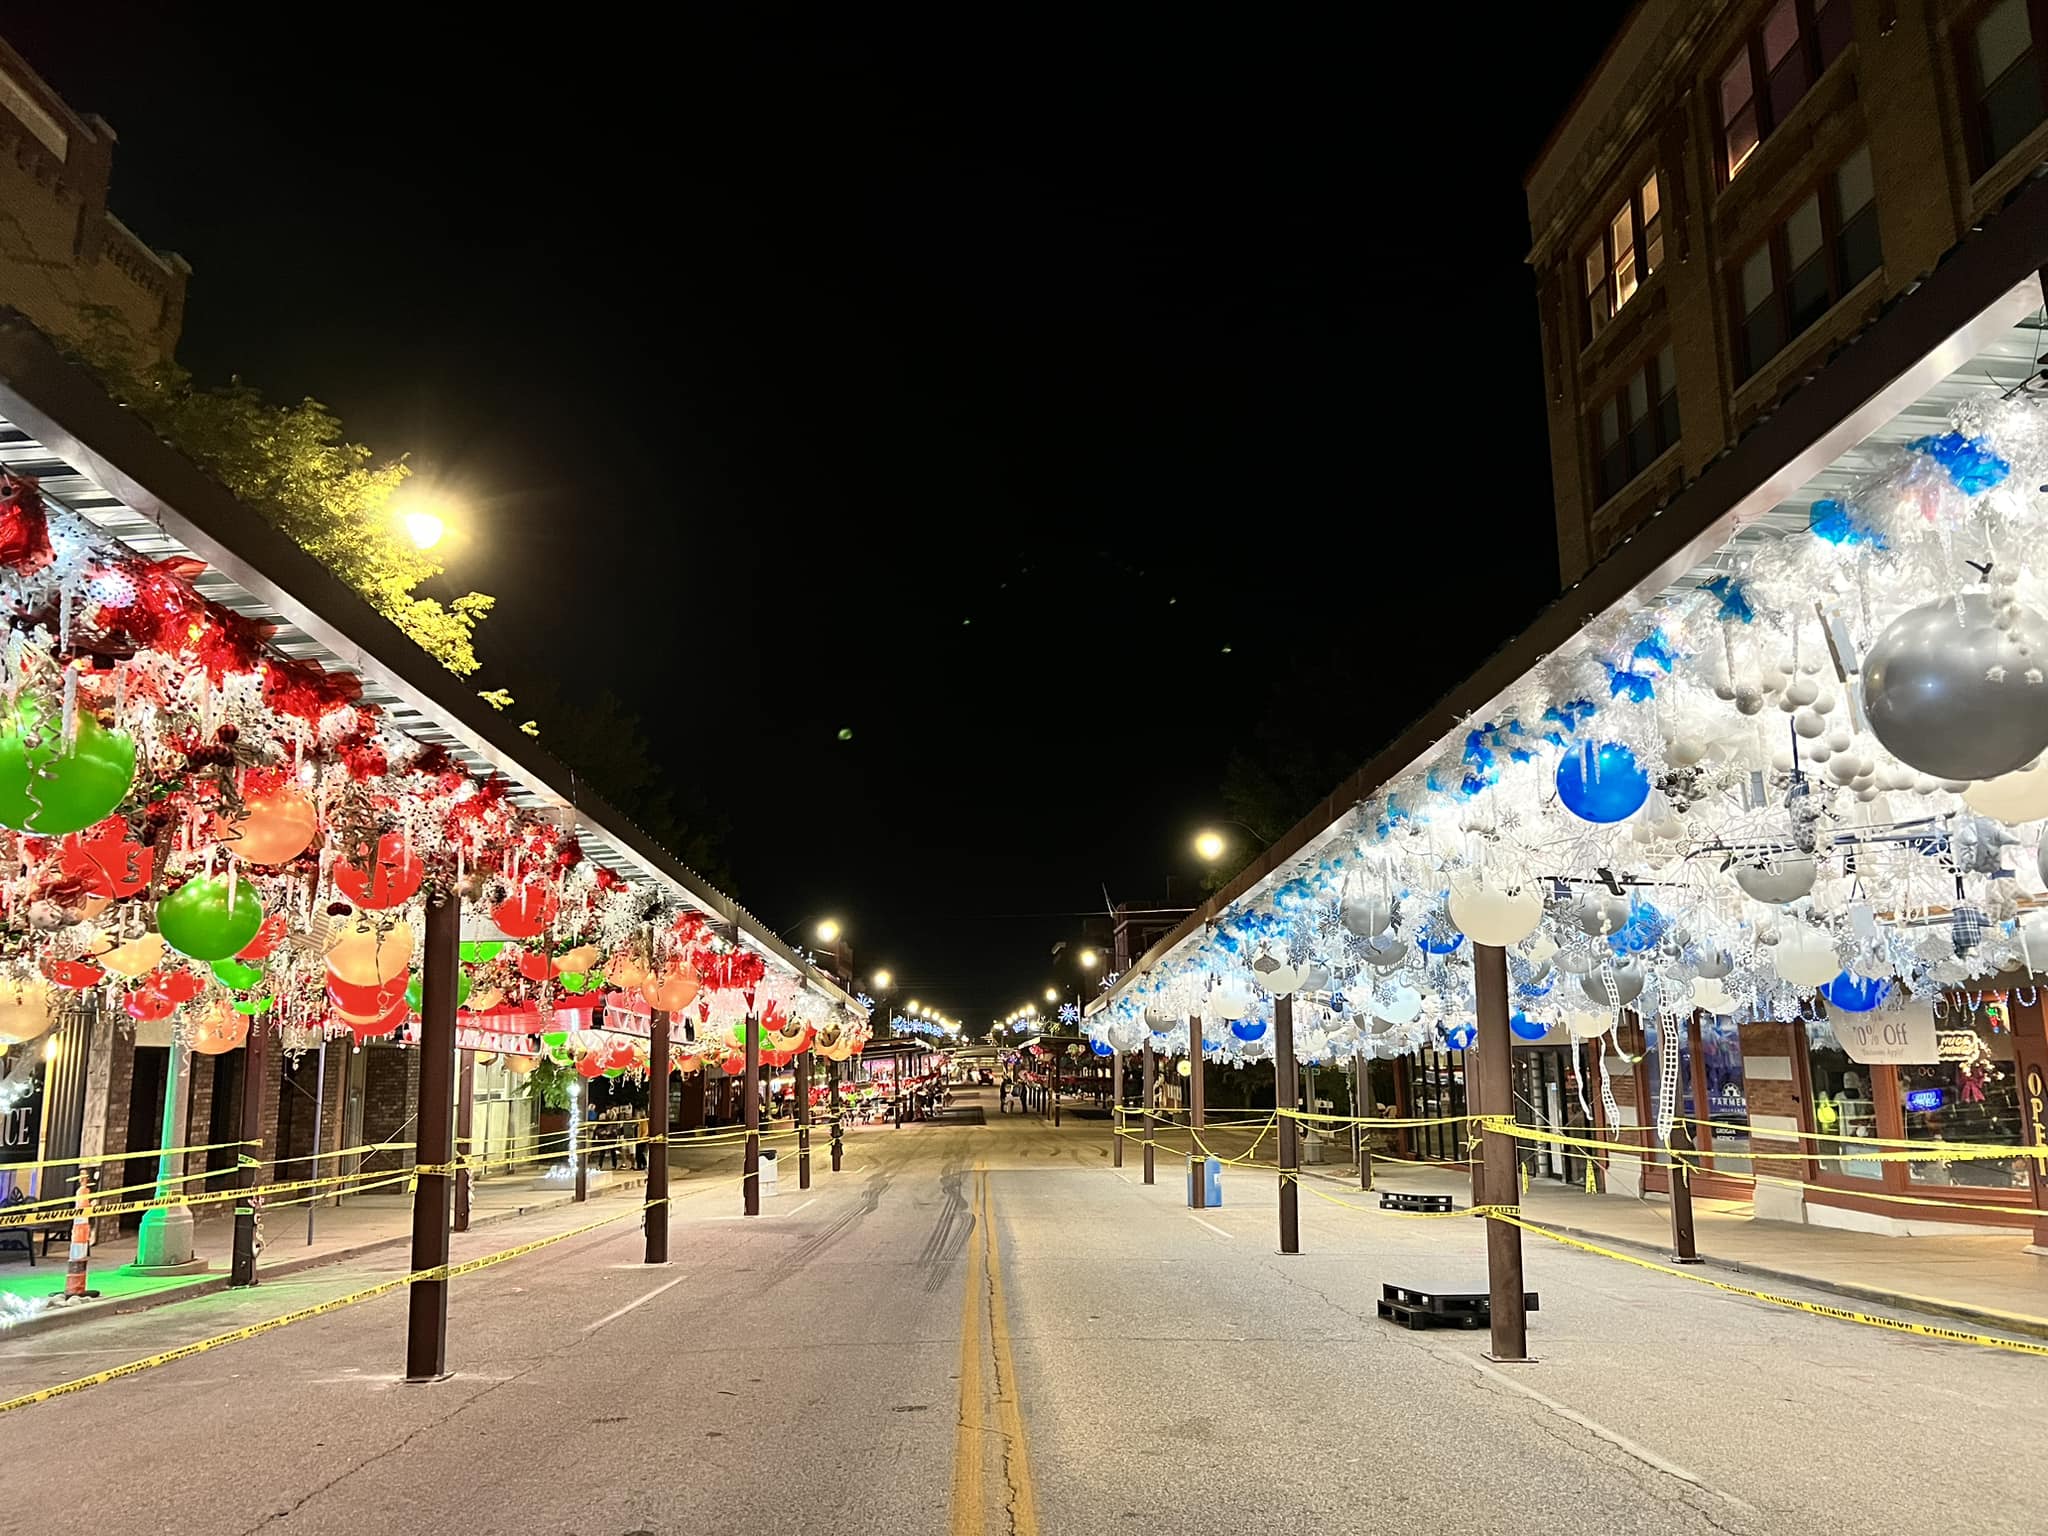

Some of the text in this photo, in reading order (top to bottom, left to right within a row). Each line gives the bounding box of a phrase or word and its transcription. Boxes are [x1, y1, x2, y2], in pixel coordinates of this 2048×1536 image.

[1853, 1023, 1910, 1047] 0% Off
[0, 1107, 32, 1150] CE
